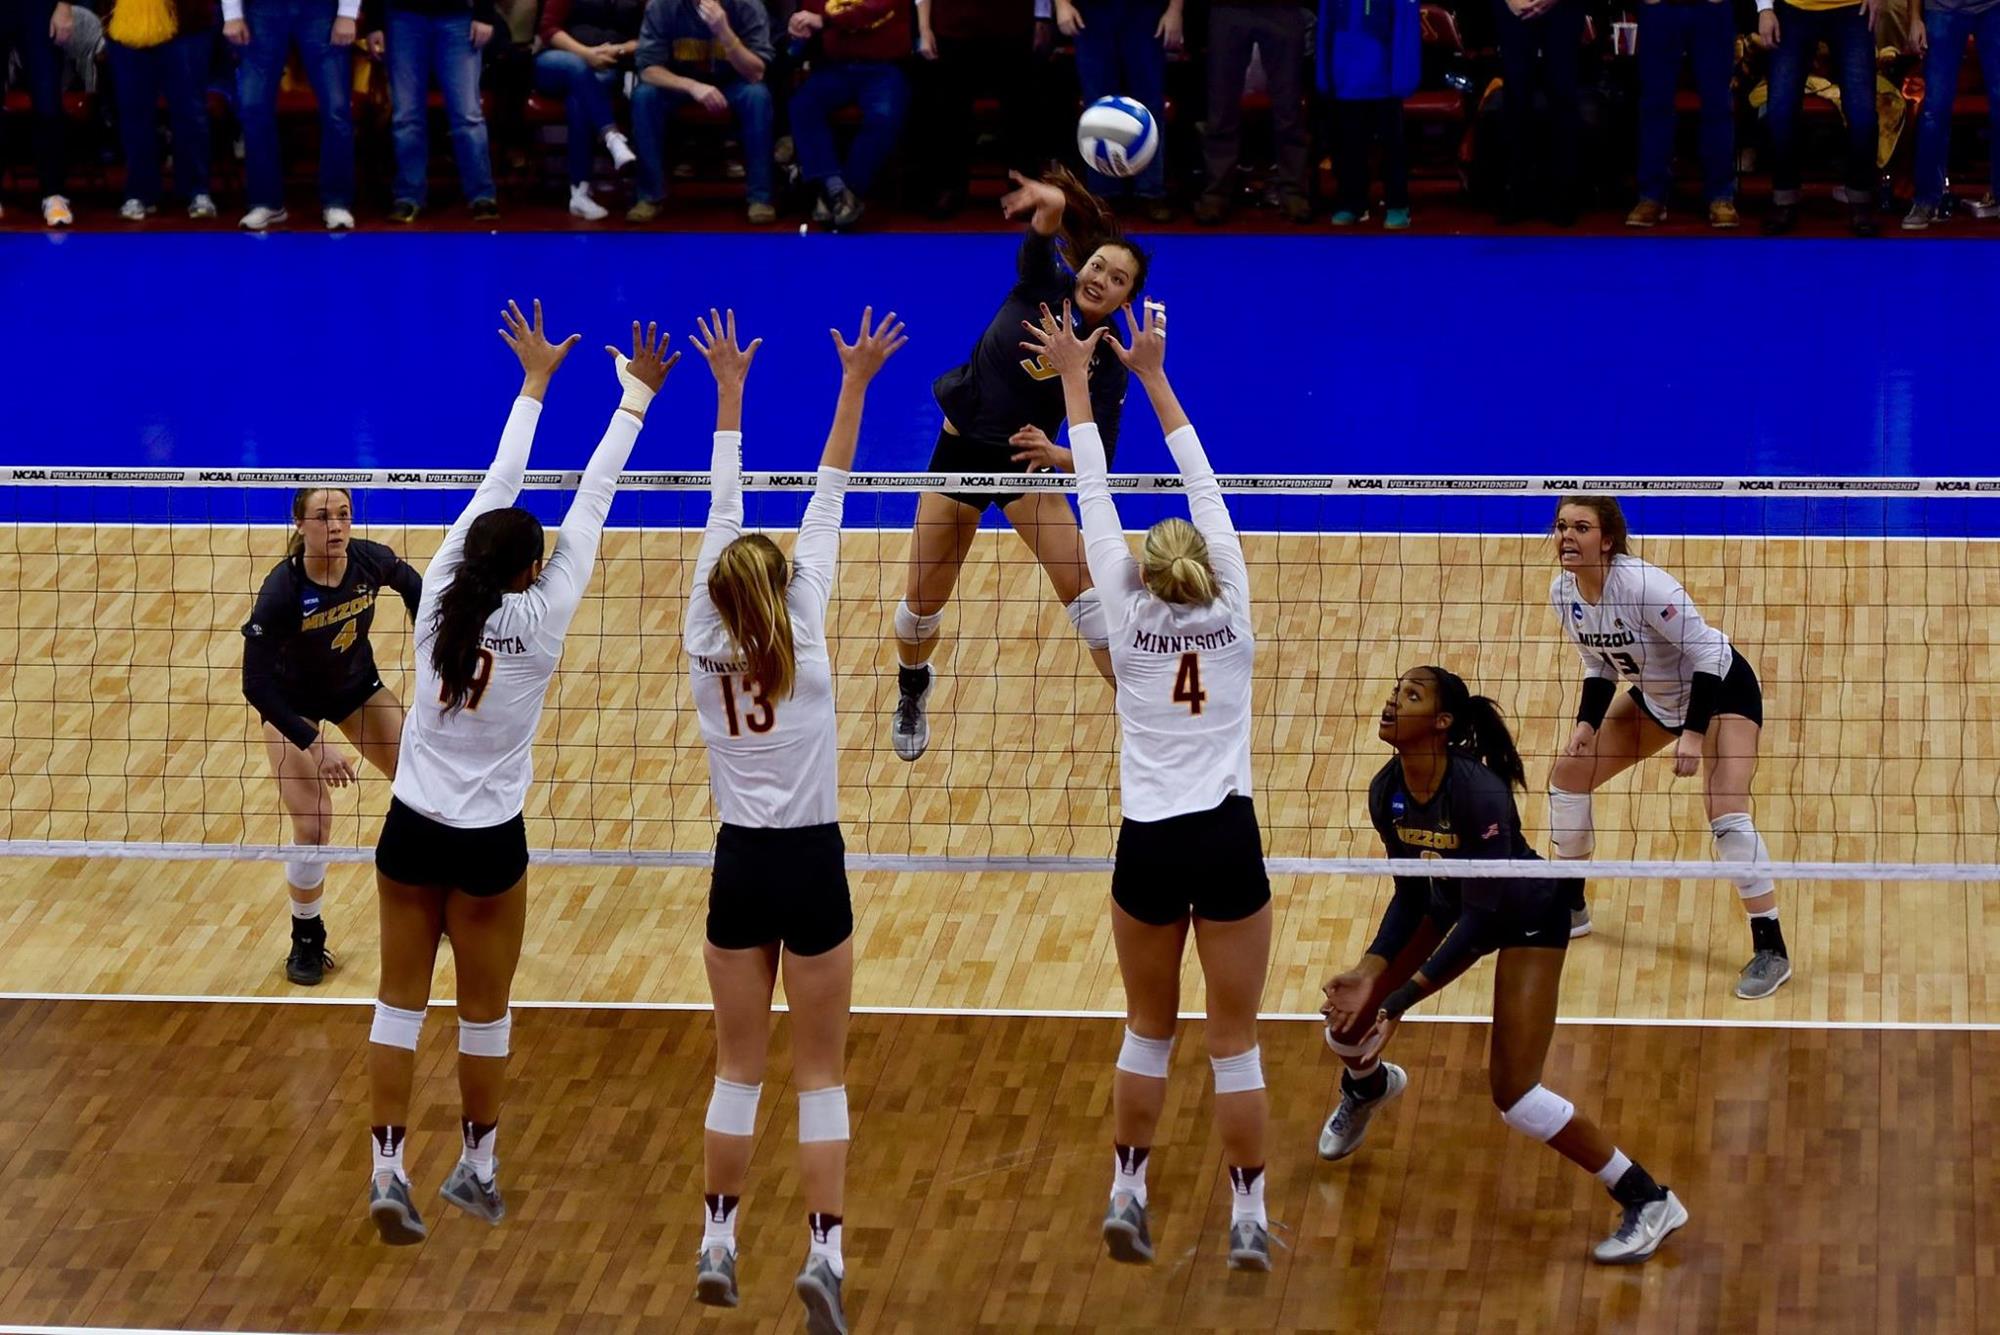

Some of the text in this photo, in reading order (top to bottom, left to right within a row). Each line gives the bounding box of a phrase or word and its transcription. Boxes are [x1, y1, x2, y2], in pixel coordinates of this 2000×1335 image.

[12, 470, 46, 479] NCAA
[111, 472, 184, 480] CHAMPIONSHIP
[198, 472, 233, 481] NCAA
[387, 474, 421, 482] NCAA
[618, 475, 677, 483] VOLLEYBALL
[769, 476, 804, 485] NCAA
[870, 477, 945, 485] CHAMPIONSHIP
[960, 477, 995, 486] NCAA
[1002, 478, 1060, 486] VOLLEYBALL
[1348, 479, 1527, 488] NCAA VOLLEYBALL CHAMPIONSHIP
[1543, 480, 1723, 489] NCAA VOLLEYBALL CHAMPIONSHIP
[1739, 481, 1774, 490] NCAA
[1842, 482, 1919, 490] CHAMPIONSHIP
[1936, 482, 1970, 490] NCAA
[331, 618, 358, 653] 4
[1133, 625, 1237, 653] MINNESOTA
[1578, 630, 1635, 647] MIZZOU
[1172, 651, 1206, 716] 4
[719, 673, 777, 738] 13
